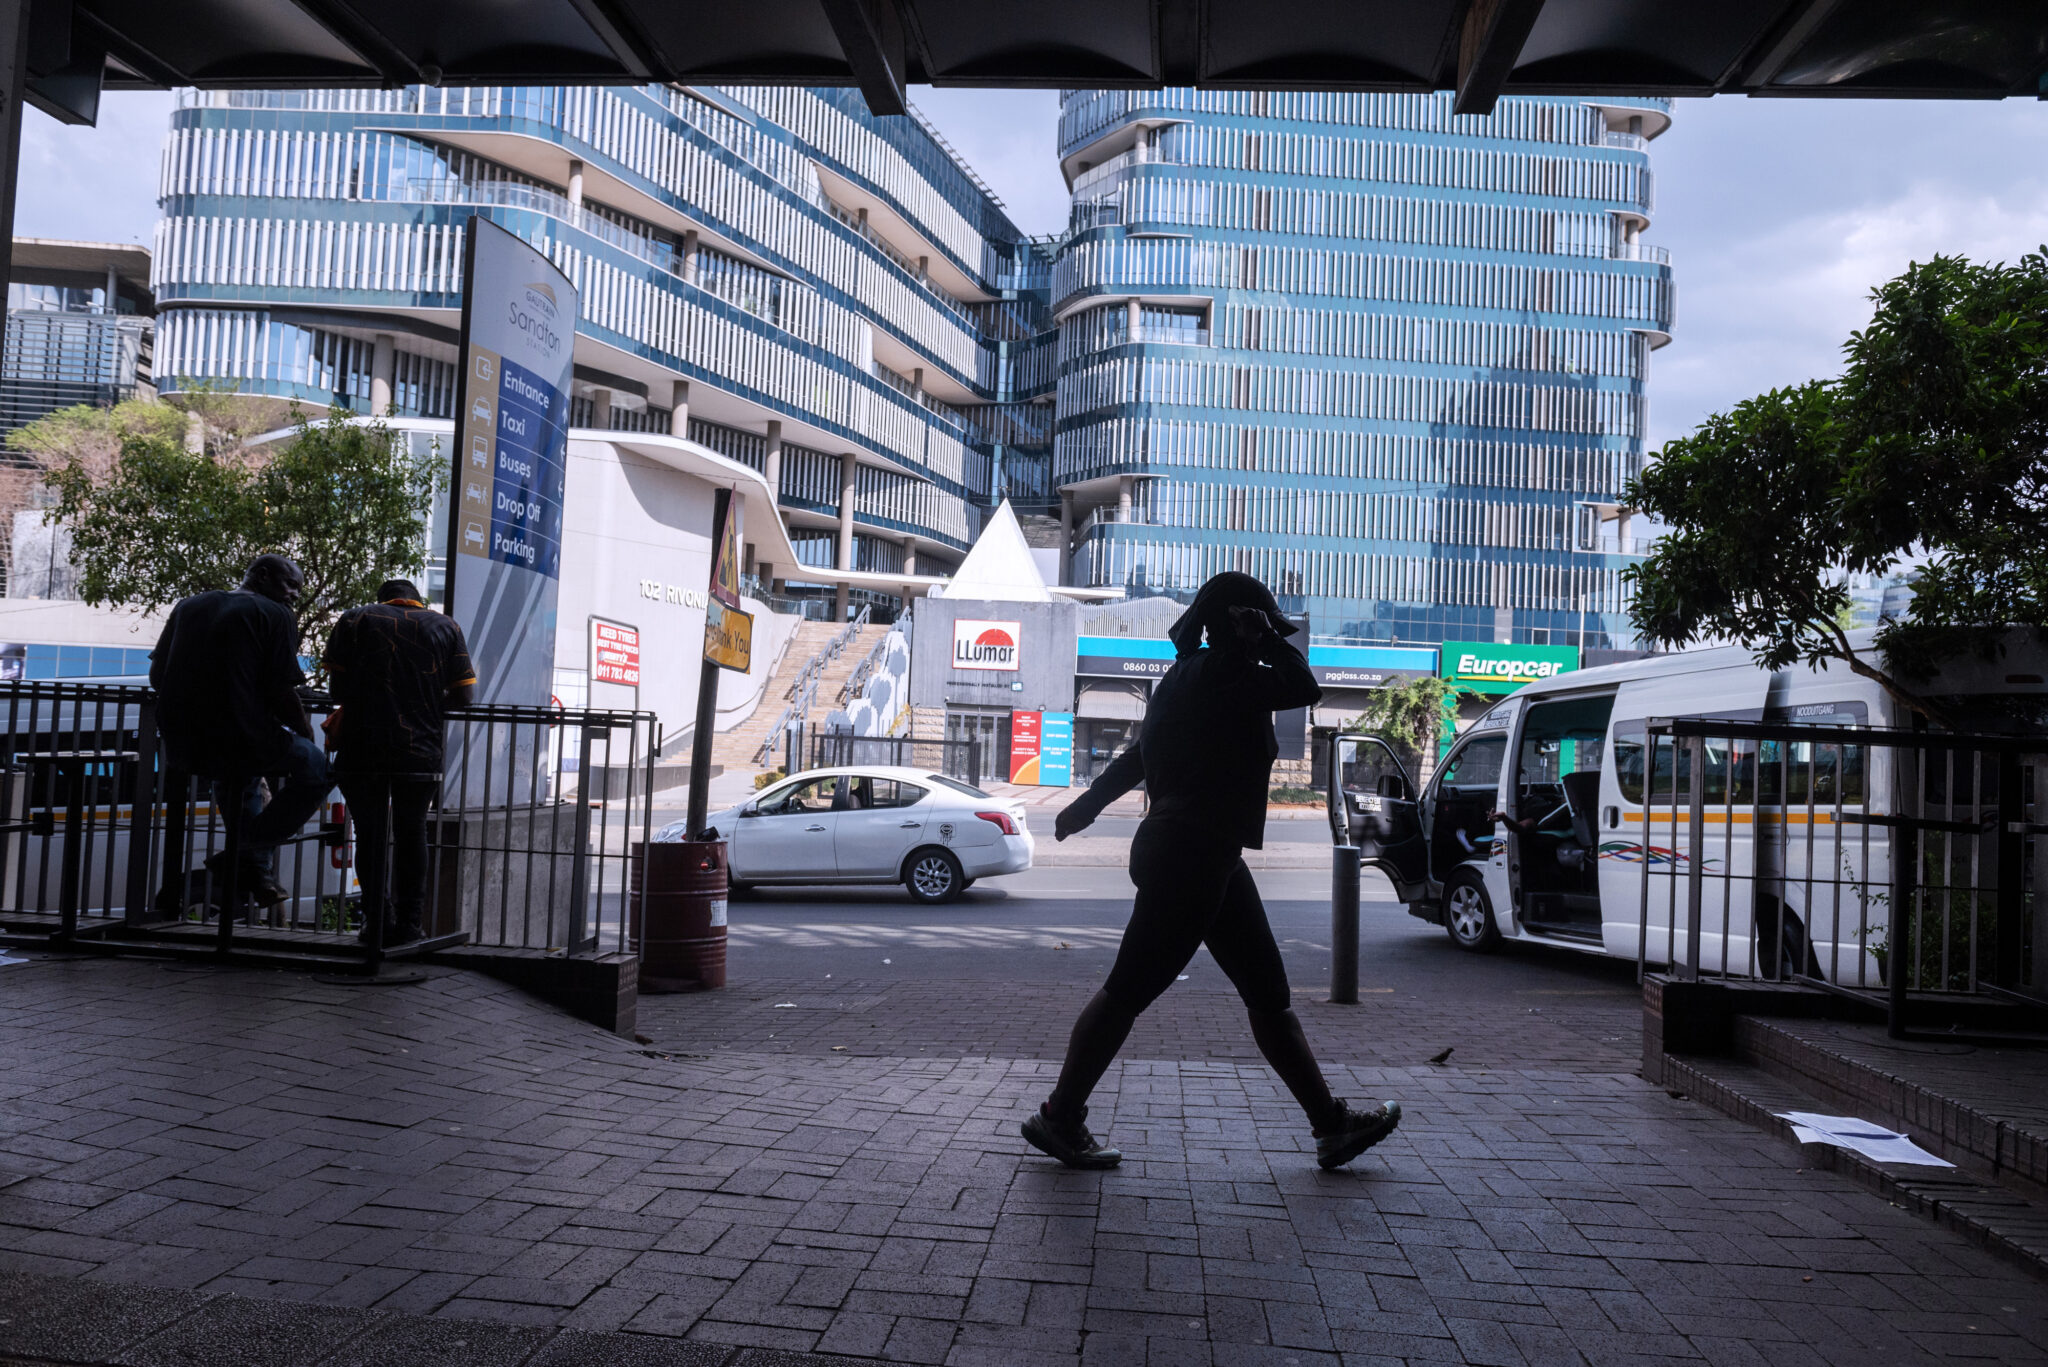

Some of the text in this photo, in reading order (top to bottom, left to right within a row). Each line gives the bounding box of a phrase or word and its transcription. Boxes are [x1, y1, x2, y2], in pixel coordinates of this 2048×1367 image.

[526, 290, 556, 318] GAUTRAIN
[509, 301, 560, 354] Sandton
[504, 369, 550, 409] Entrance
[501, 410, 526, 437] Taxi
[499, 451, 532, 479] Buses
[497, 491, 541, 523] Drop Off
[494, 534, 535, 564] Parking
[640, 579, 661, 601] 102
[600, 626, 637, 645] NEED TYRES
[734, 630, 750, 654] You
[957, 639, 1015, 663] LLumar
[597, 663, 610, 678] 011
[1123, 662, 1173, 673] 0860 03 0
[1325, 670, 1382, 681] pgglass.co.za
[1457, 653, 1563, 682] Europcar
[1797, 704, 1834, 716] NOODUITGANG
